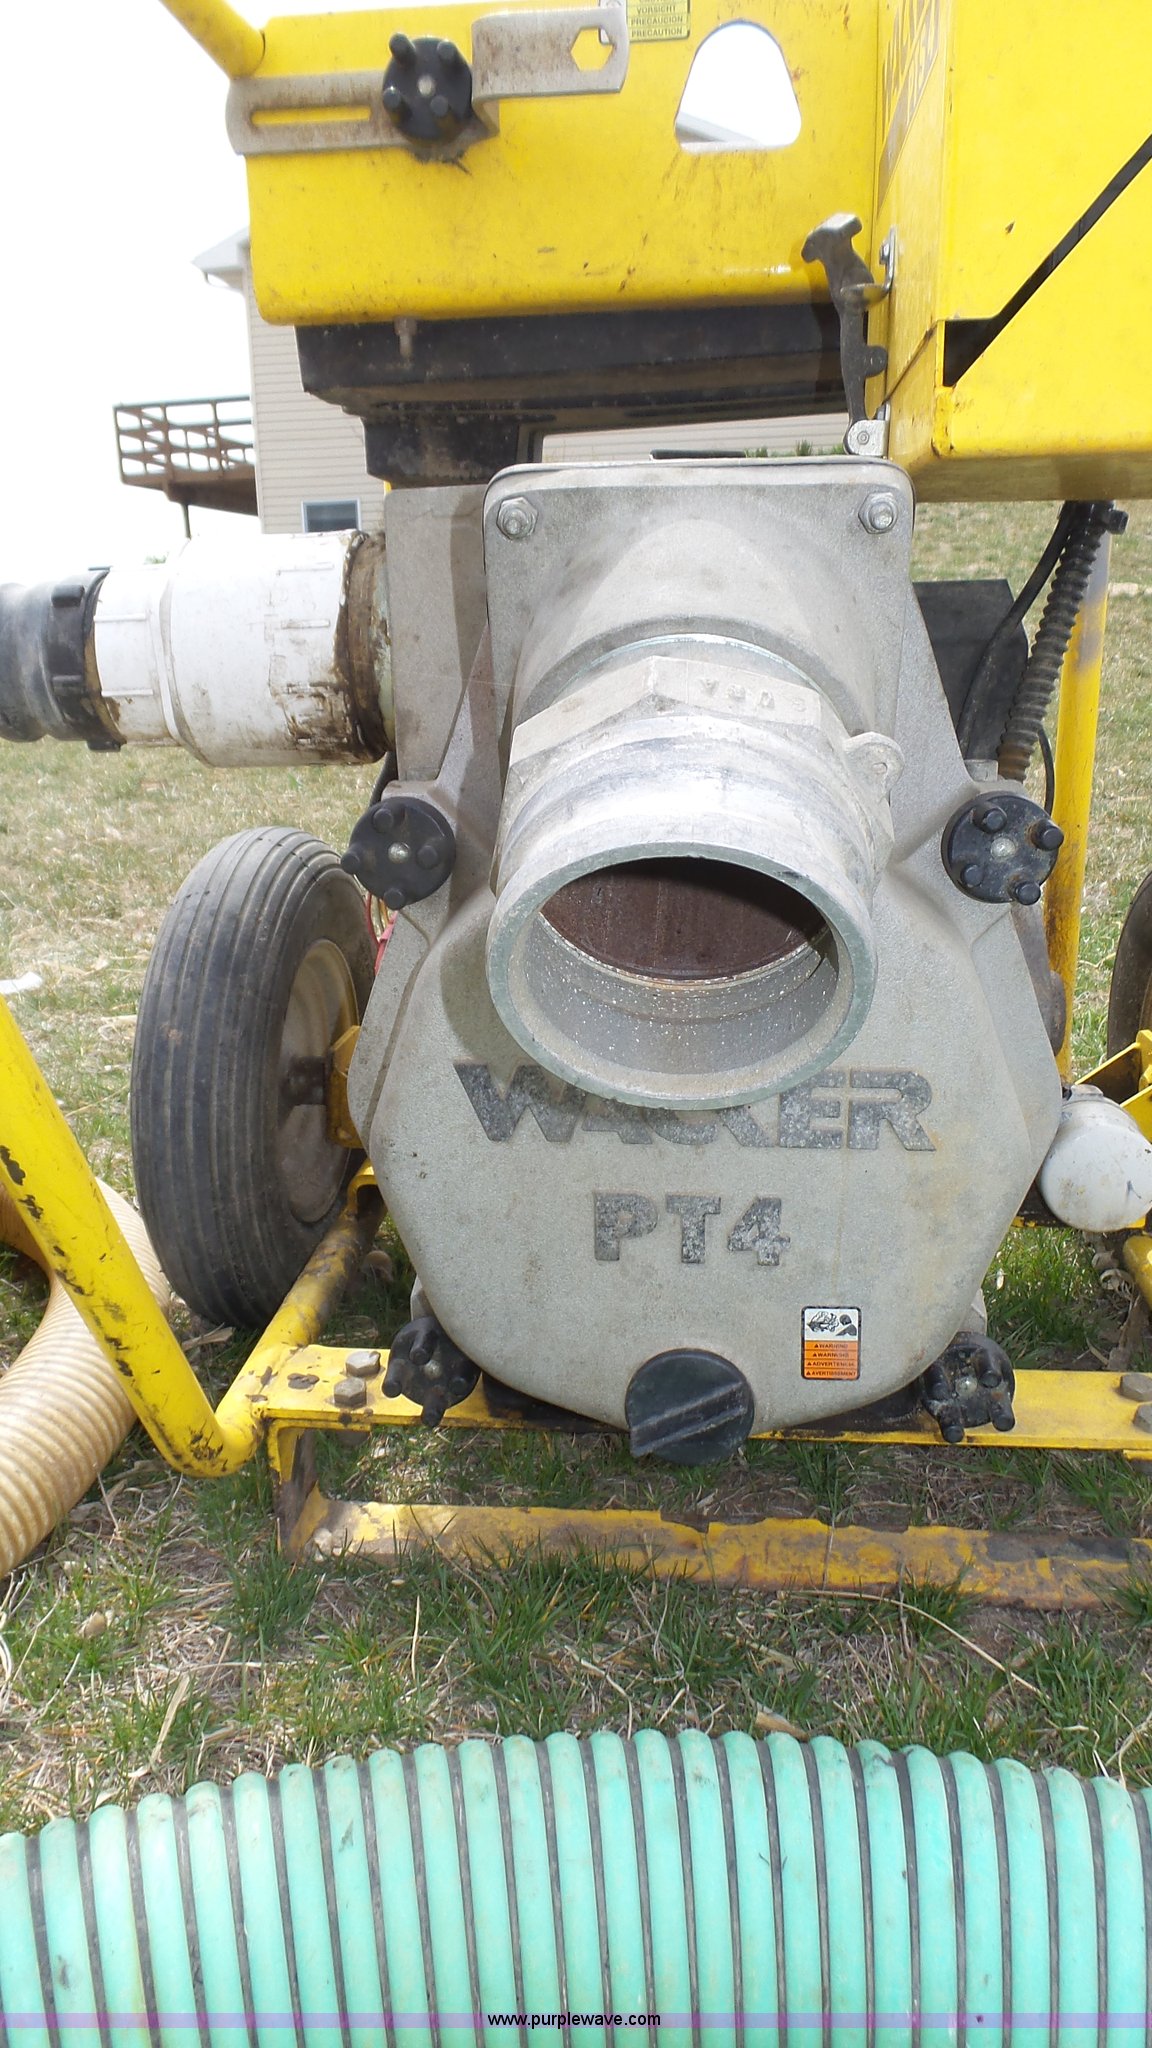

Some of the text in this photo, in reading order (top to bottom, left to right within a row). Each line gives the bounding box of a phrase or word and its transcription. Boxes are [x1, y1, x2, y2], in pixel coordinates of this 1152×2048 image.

[636, 5, 676, 15] VORSICHT
[631, 27, 683, 38] PRECAUTION
[593, 1193, 791, 1267] PT4
